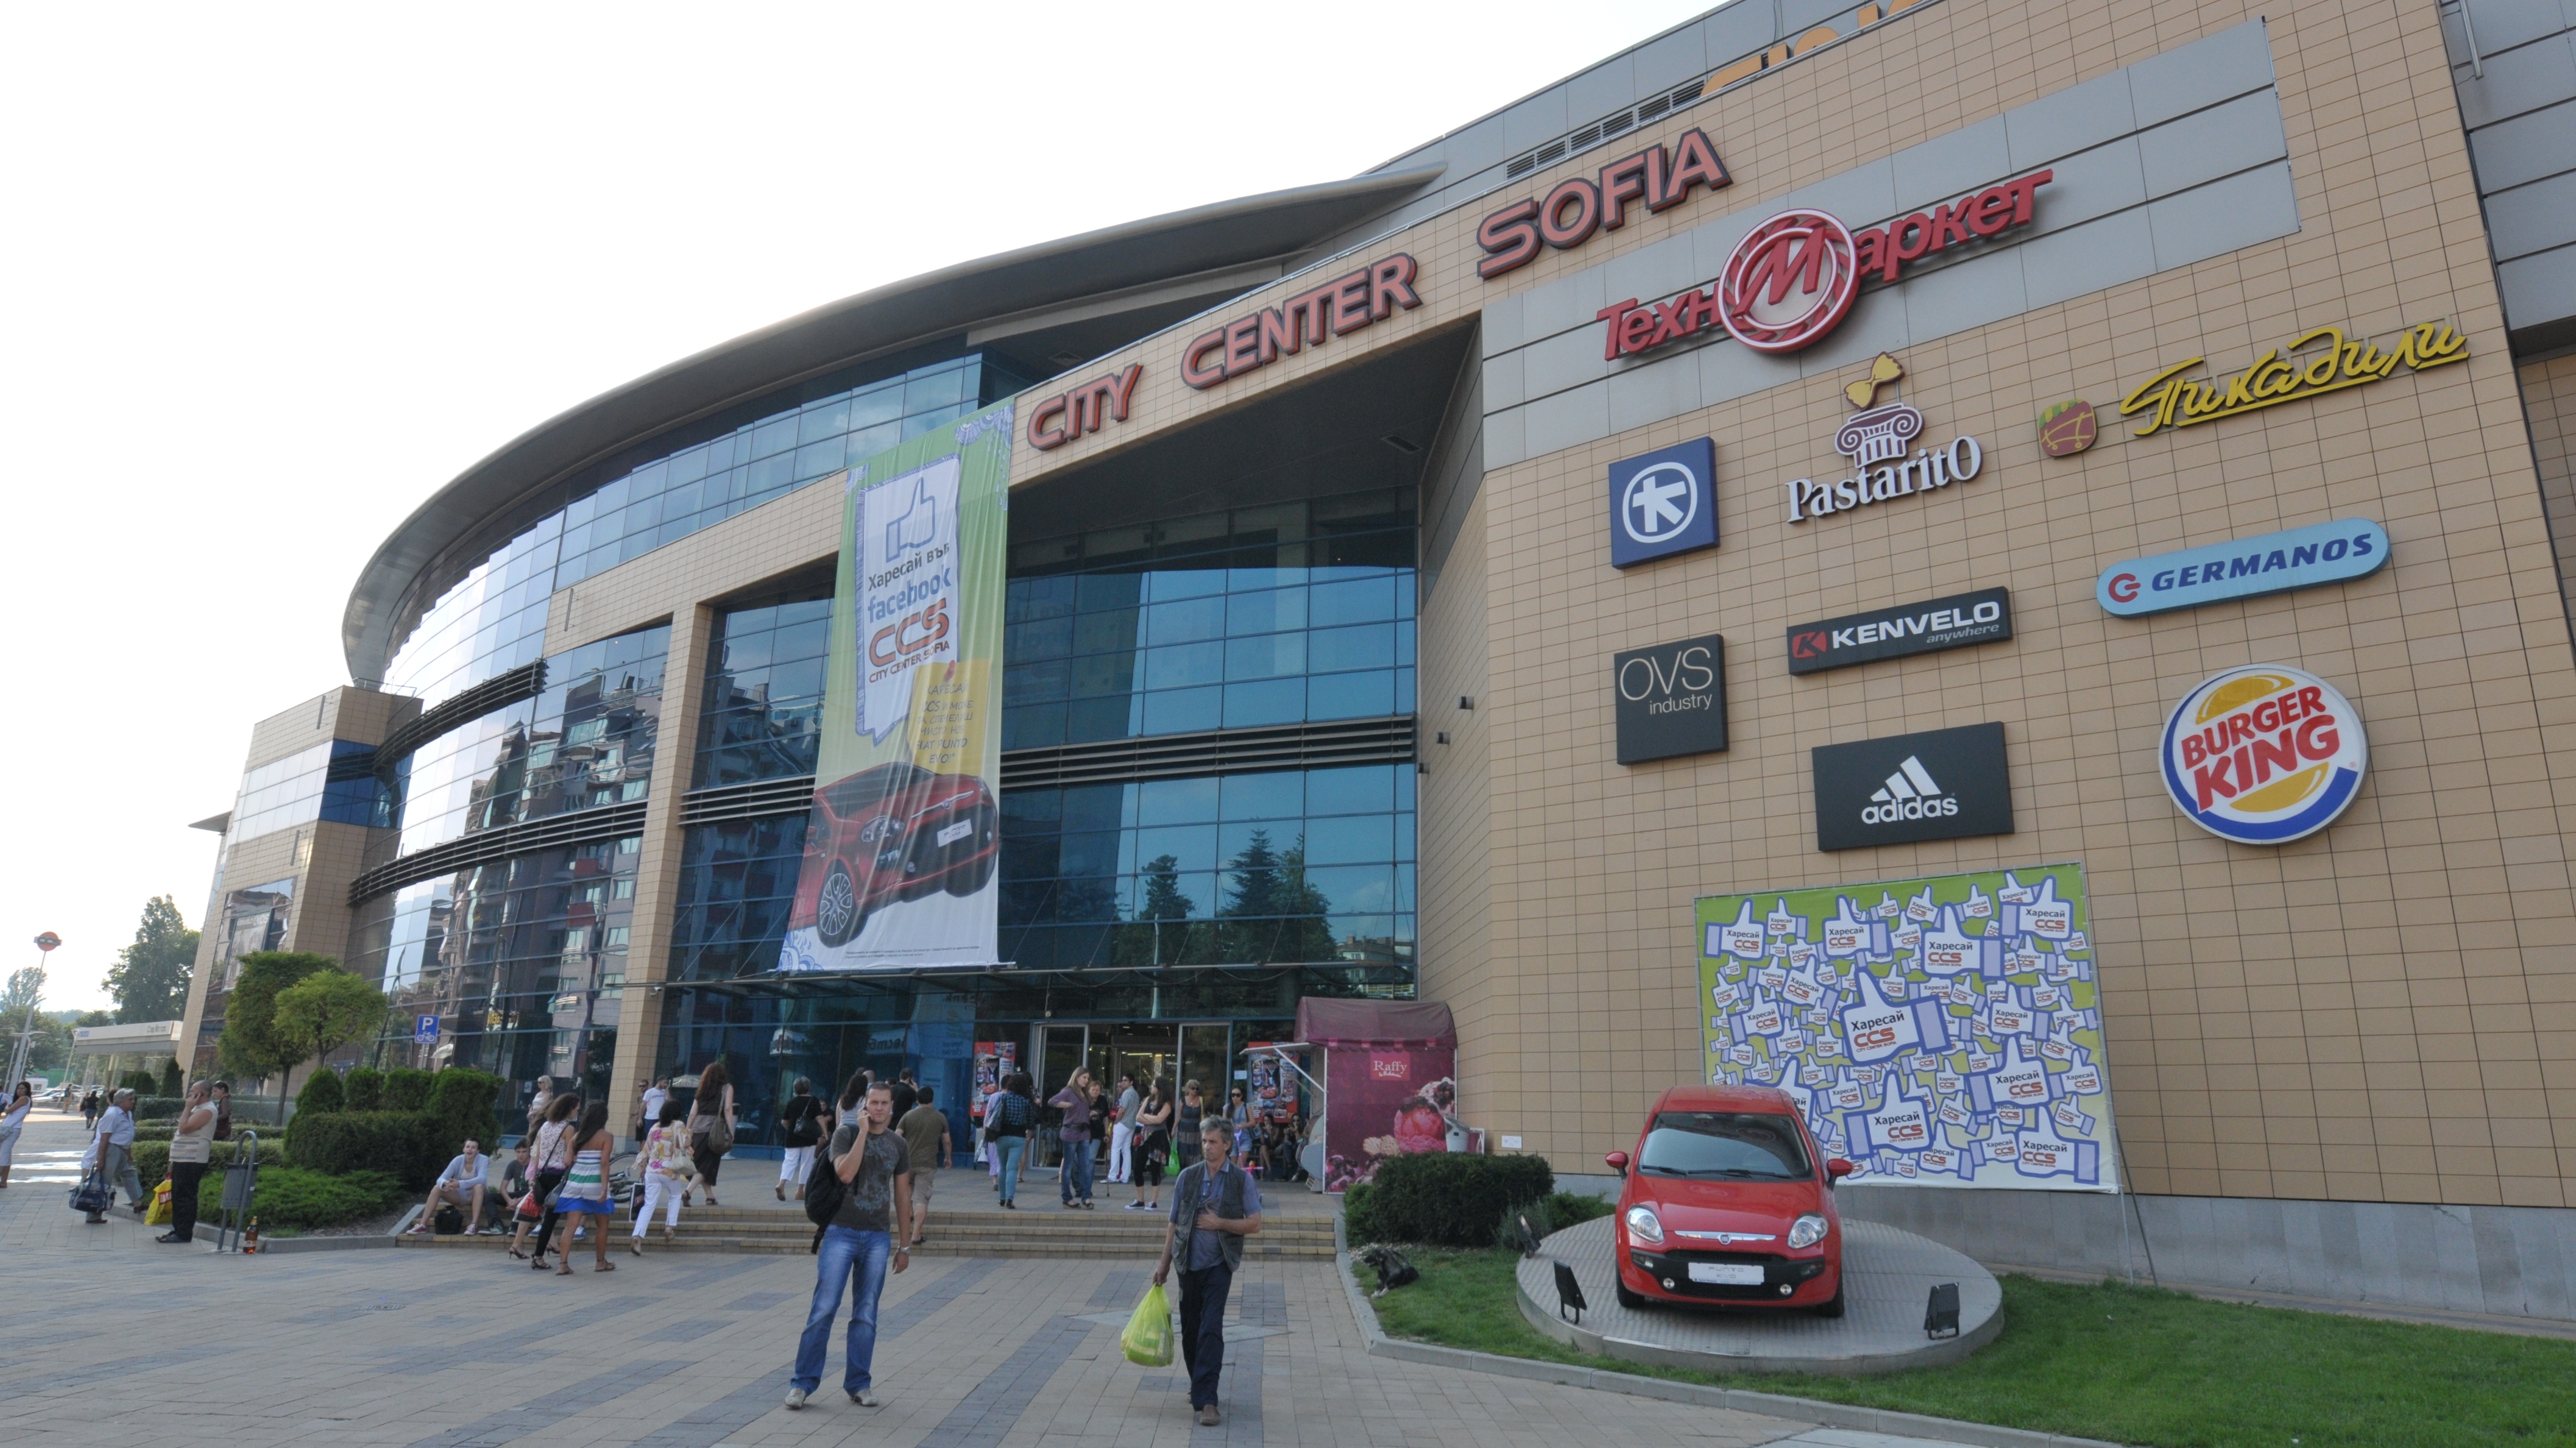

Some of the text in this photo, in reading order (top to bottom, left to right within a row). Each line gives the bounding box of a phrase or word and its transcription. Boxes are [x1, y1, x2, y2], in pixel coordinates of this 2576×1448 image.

[1027, 126, 1732, 451] CITY CENTER SOFIA
[2119, 322, 2471, 436] Пикадили
[2151, 533, 2373, 592] GERMANOS
[868, 550, 922, 591] Харесай
[868, 564, 952, 623] facebook
[1832, 601, 2000, 650] KENVELO
[869, 597, 949, 667] CCS
[1926, 623, 1999, 644] anywhere
[869, 640, 950, 683] CITY CENTER SOFIA
[1619, 647, 1713, 701] OVS
[1649, 694, 1713, 715] industry
[2181, 686, 2326, 770] BURGER
[938, 737, 968, 749] PUNTO
[2193, 714, 2340, 811] KING
[1861, 795, 1959, 824] adidas
[2002, 890, 2028, 900] Харесай
[1910, 907, 1927, 917] CCS
[1912, 901, 1934, 912] Харесай
[2026, 909, 2065, 918] Харесай
[2034, 919, 2065, 929] CCS
[1727, 929, 1760, 939] Харесай
[1829, 926, 1864, 936] Харесай
[1894, 929, 1918, 939] Харесай
[1734, 939, 1760, 950] CCS
[1829, 936, 1856, 946] CCS
[1902, 935, 1920, 944] CCS
[1791, 946, 1813, 955] Харесай
[1929, 941, 1973, 951] Харесай
[1928, 952, 1962, 963] CCS
[1791, 976, 1819, 993] Харесай
[1716, 986, 1735, 996] Харесай
[1788, 984, 1810, 998] CCS
[1953, 992, 1967, 1001] CCS
[1955, 988, 1973, 997] Харесай
[1718, 993, 1732, 1003] CCS
[1747, 1009, 1775, 1021] Харесай
[1995, 1009, 2028, 1018] Харесай
[422, 1017, 433, 1031] P
[1756, 1017, 1778, 1028] CCS
[1851, 1010, 1905, 1031] Харесай
[1994, 1017, 2019, 1027] CCS
[1854, 1027, 1895, 1047] CCS
[2045, 1043, 2065, 1054] CCS
[1373, 1060, 1407, 1074] Raffy
[1995, 1070, 2040, 1084] Харесай
[2066, 1071, 2095, 1081] Харесай
[2009, 1081, 2043, 1096] CCS
[2075, 1079, 2097, 1088] CCS
[1832, 1086, 1857, 1095] Харесай
[1839, 1093, 1859, 1102] CCS
[1942, 1109, 1960, 1120] CCS
[1945, 1104, 1967, 1116] Харесай
[2060, 1107, 2081, 1119] Харесай
[1874, 1111, 1920, 1126] Харесай
[2058, 1112, 2074, 1122] CCS
[1888, 1124, 1923, 1138] CCS
[1986, 1139, 2013, 1148] Харесай
[2023, 1140, 2067, 1152] Харесай
[1994, 1146, 2015, 1155] CCS
[1923, 1154, 1947, 1164] CCS
[2022, 1151, 2056, 1164] CCS
